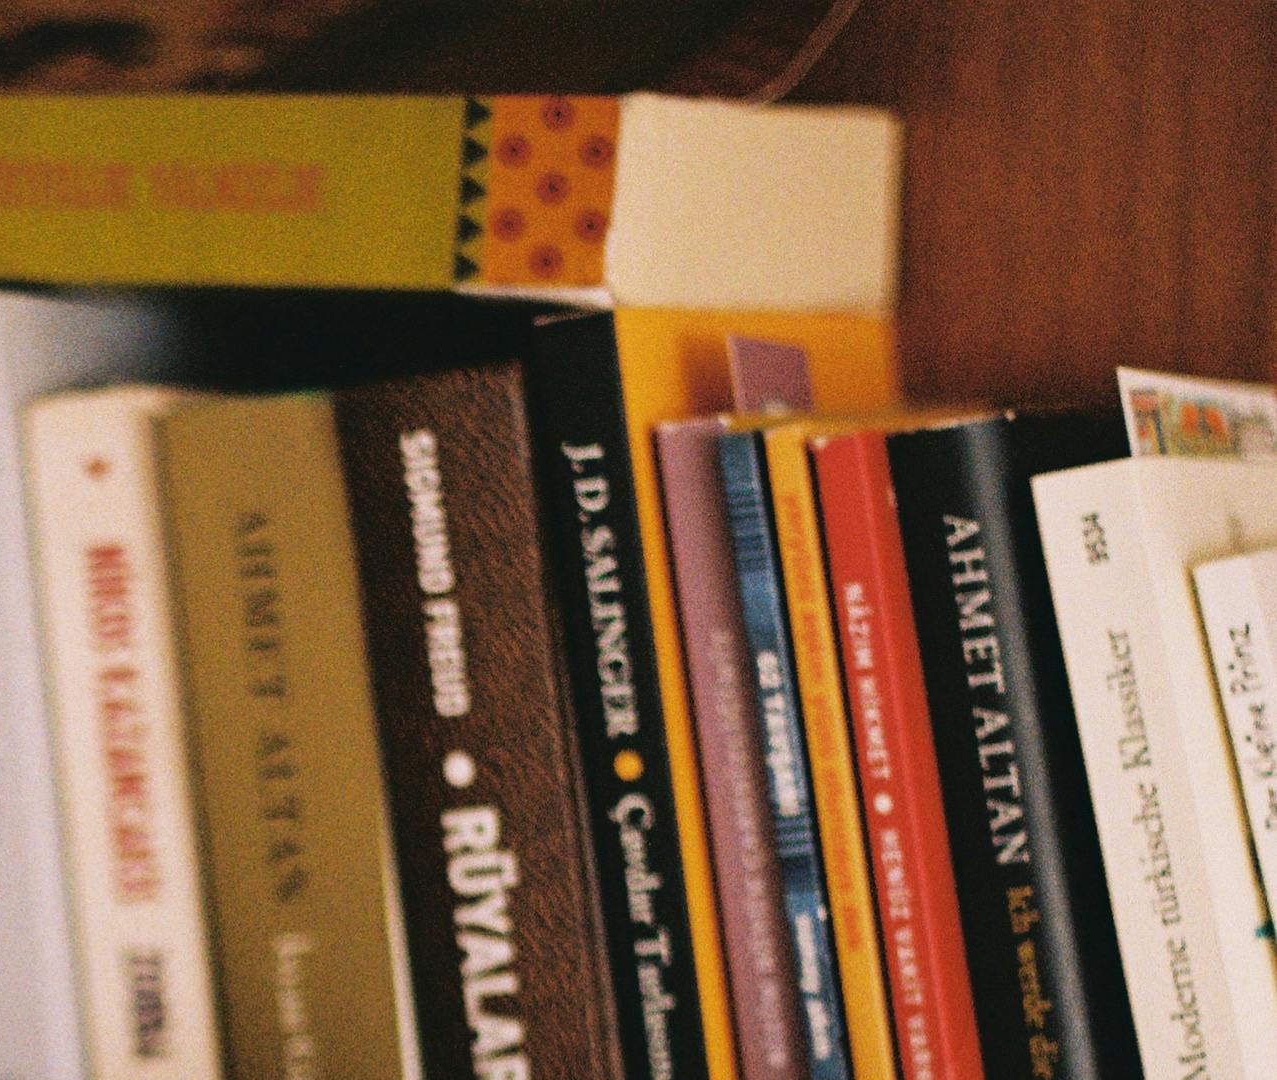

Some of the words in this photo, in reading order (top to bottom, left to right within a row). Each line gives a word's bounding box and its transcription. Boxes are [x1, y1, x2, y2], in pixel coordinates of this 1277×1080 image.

[399, 428, 456, 593] SIGMUND
[561, 441, 606, 474] J.
[572, 476, 612, 524] D.
[235, 511, 288, 700] AHMET
[422, 599, 472, 718] FREUD
[580, 525, 640, 739] SALINGER
[942, 514, 1007, 695] AHMET
[1106, 627, 1153, 772] Klassiker
[257, 731, 311, 902] ALTAN
[972, 705, 1031, 867] ALTAN
[1131, 782, 1183, 928] türkische
[1006, 884, 1041, 936] Ich
